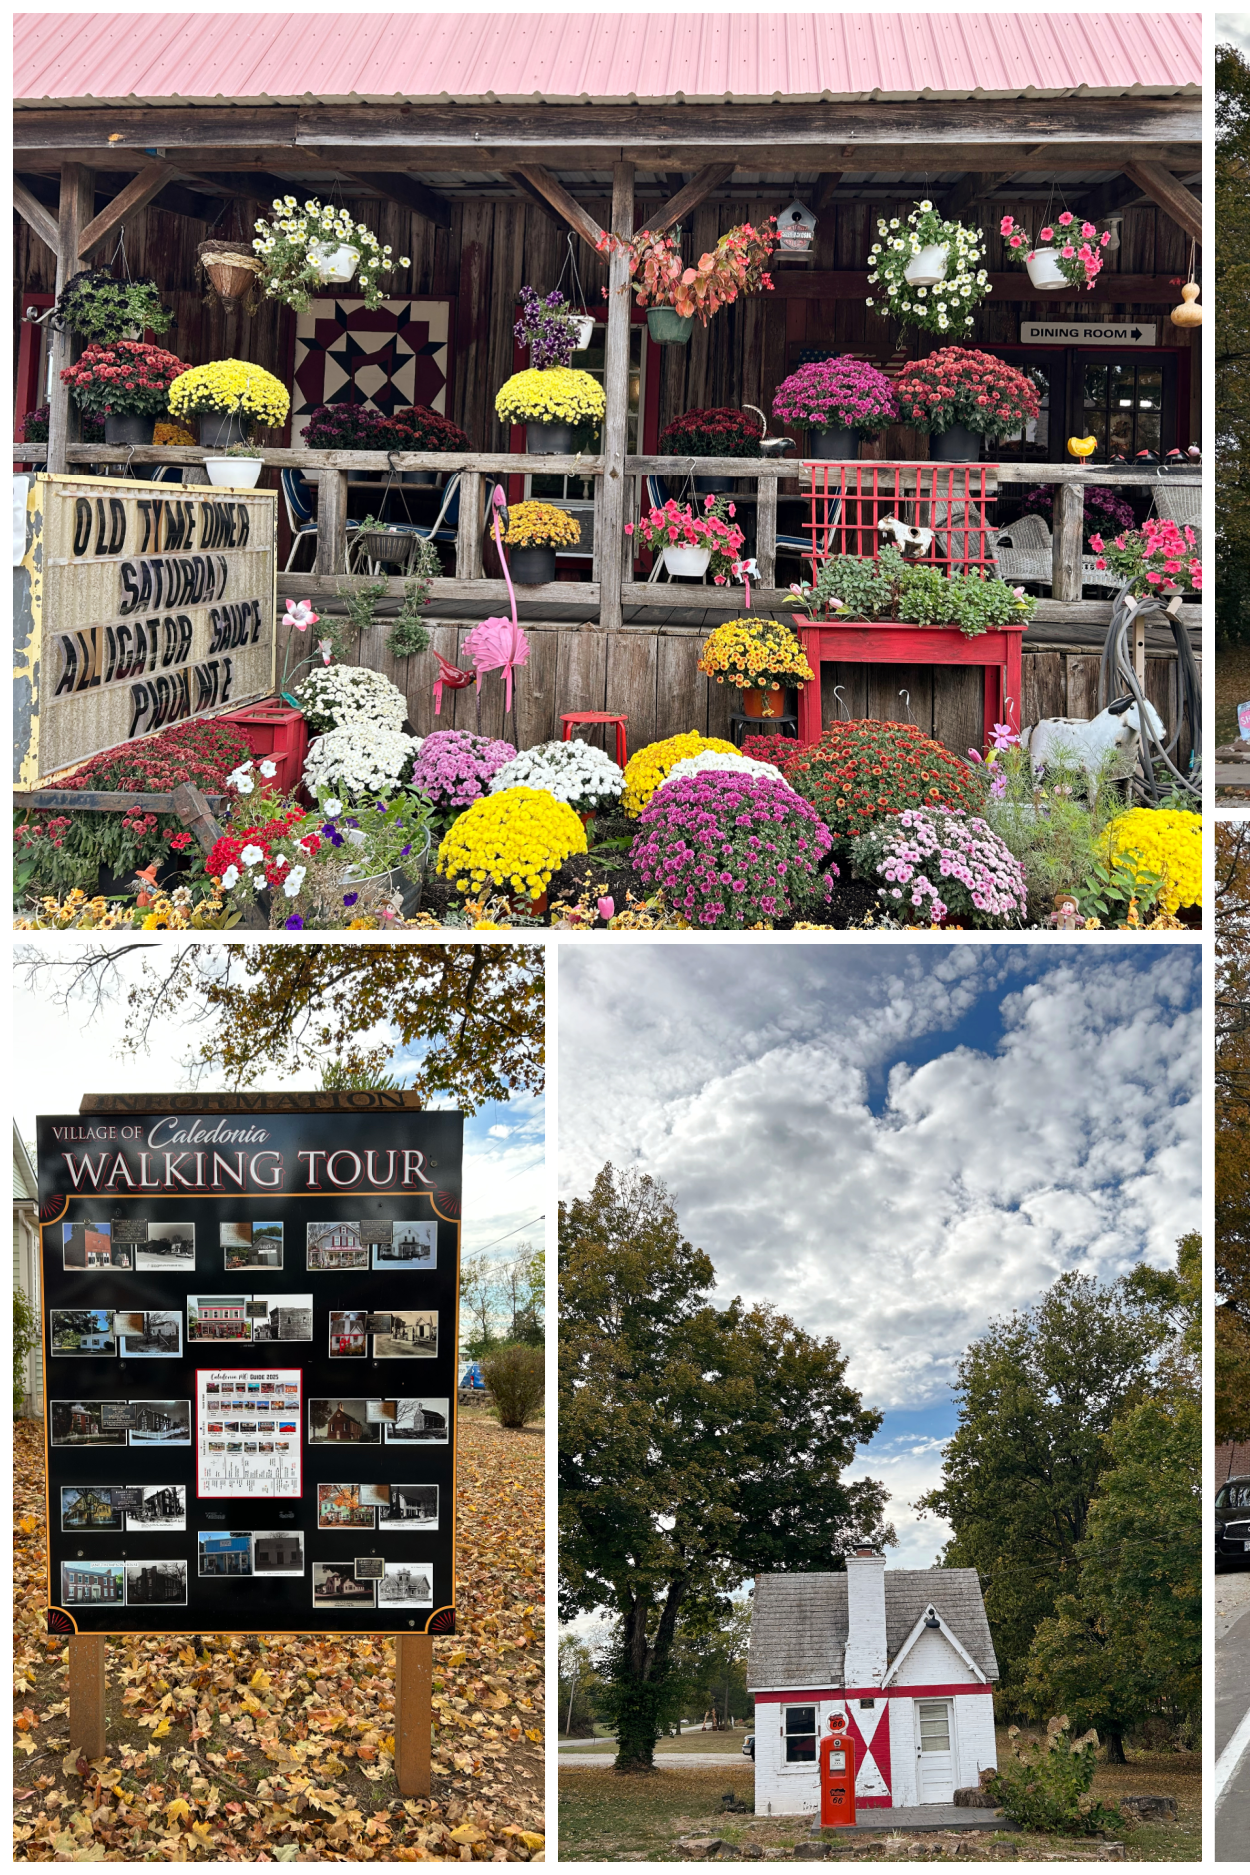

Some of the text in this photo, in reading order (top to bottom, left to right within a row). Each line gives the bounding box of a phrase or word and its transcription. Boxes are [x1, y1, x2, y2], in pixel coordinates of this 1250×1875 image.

[1030, 328, 1127, 339] DINING ROOM
[73, 497, 250, 556] OLD TYME DINER
[119, 555, 228, 616] SATURDAY
[55, 599, 263, 696] ALLIGATOR SAUCE
[94, 1091, 407, 1111] INFORMATION
[52, 1117, 271, 1149] VILLAGE OF Caledonia
[62, 1150, 438, 1191] WALKING TOUR
